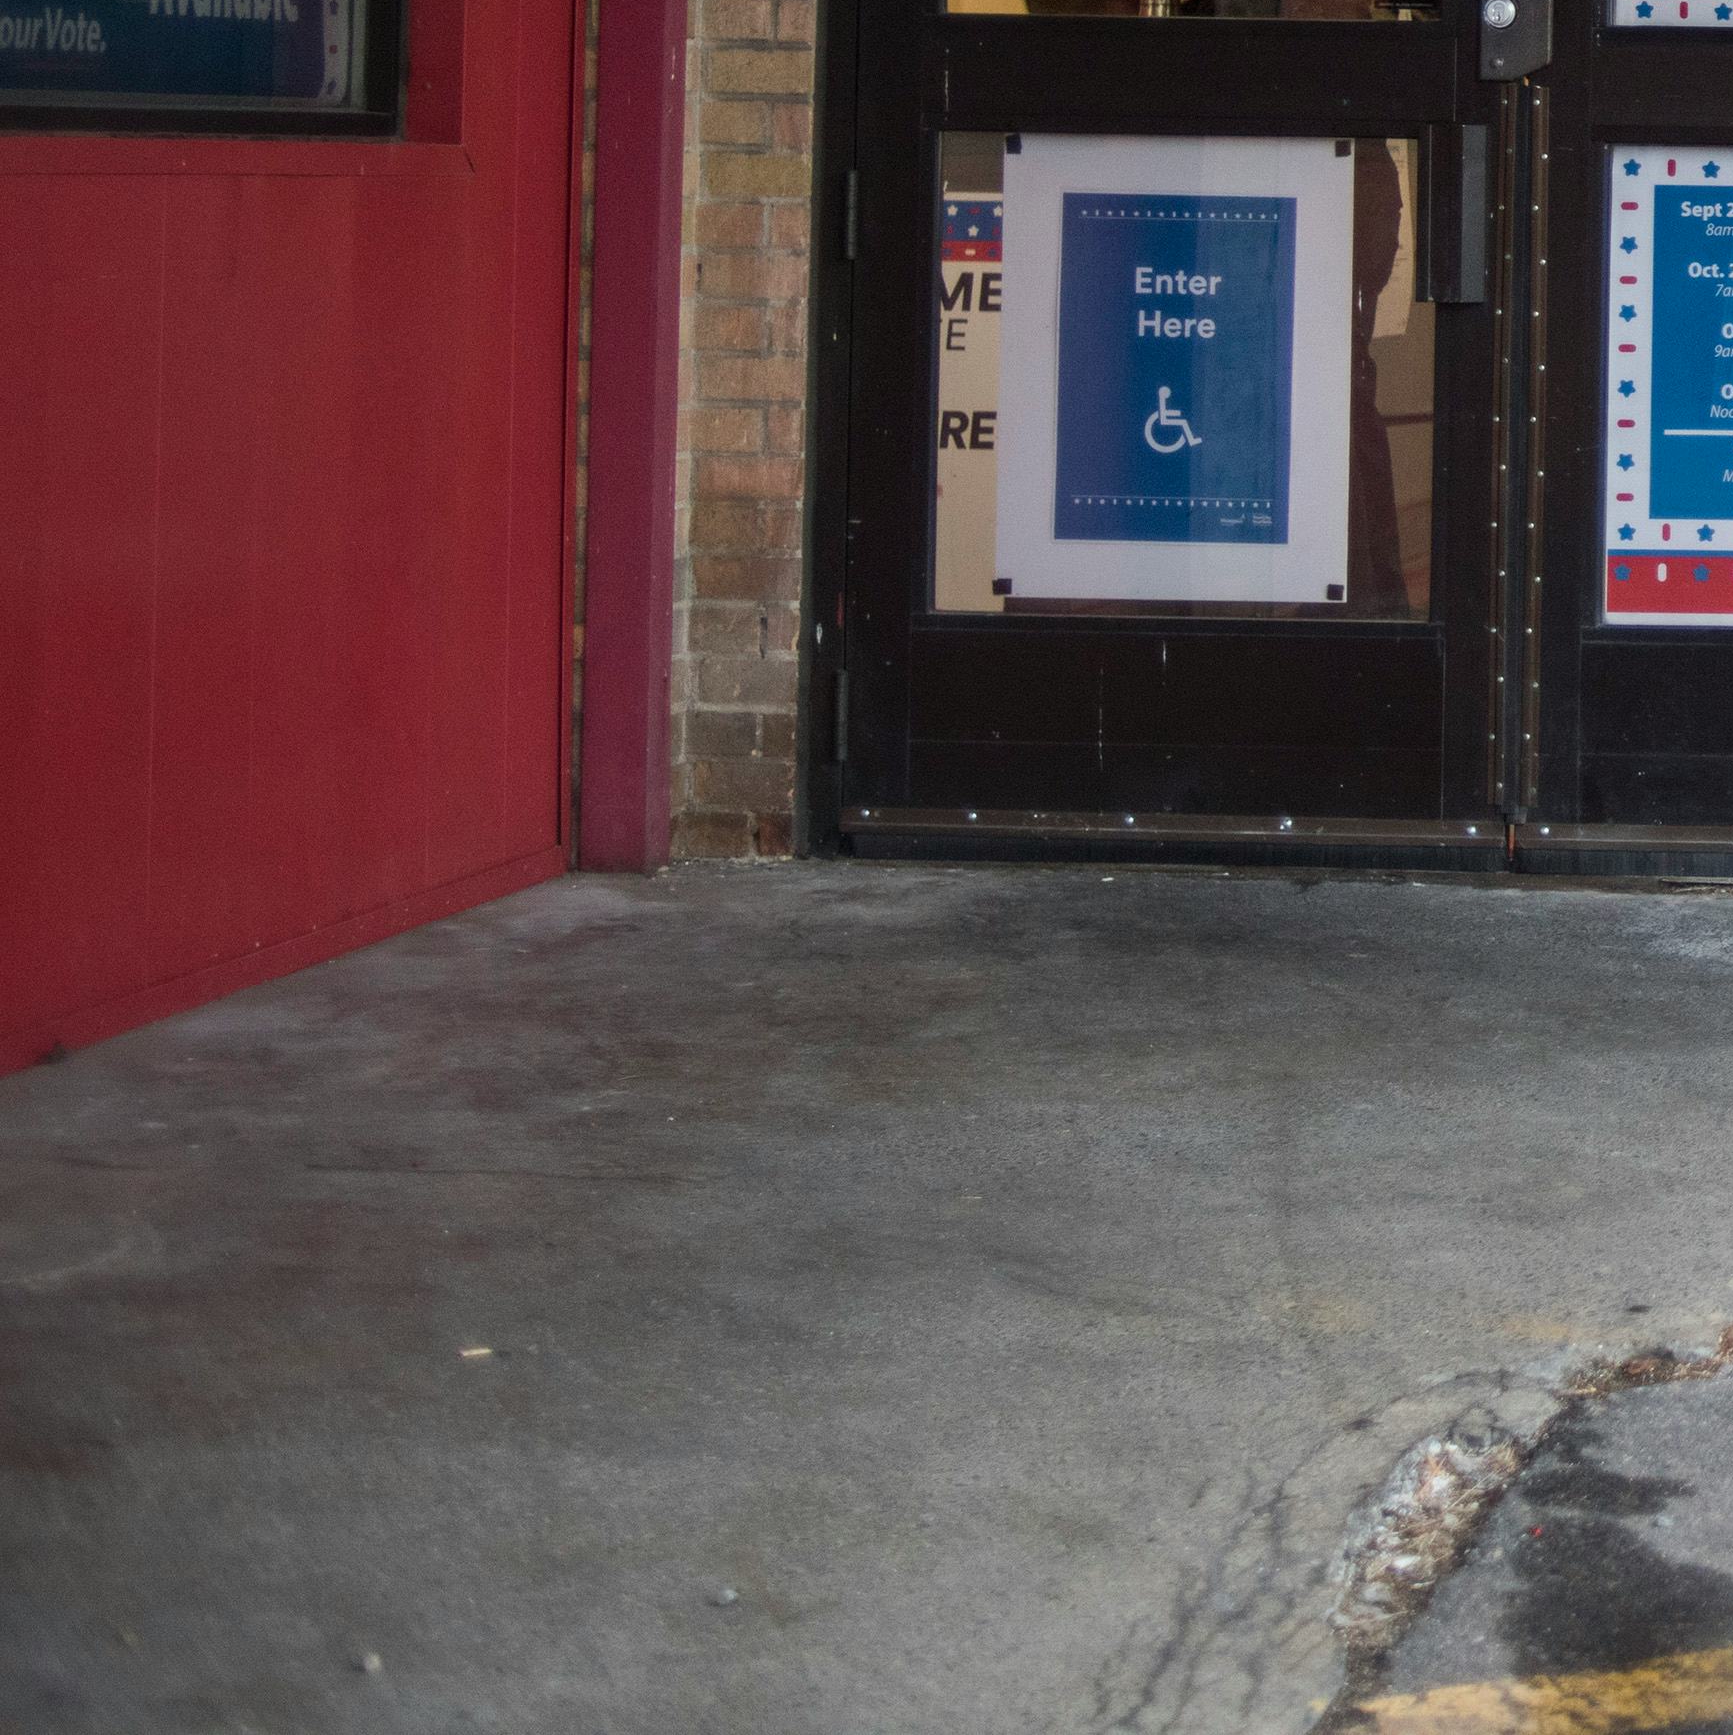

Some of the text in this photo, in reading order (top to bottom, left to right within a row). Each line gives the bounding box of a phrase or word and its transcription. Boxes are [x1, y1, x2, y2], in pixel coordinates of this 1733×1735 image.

[1680, 200, 1723, 222] Sept
[1134, 266, 1223, 296] Enter
[1687, 261, 1725, 279] Oct.
[1137, 309, 1217, 340] Here
